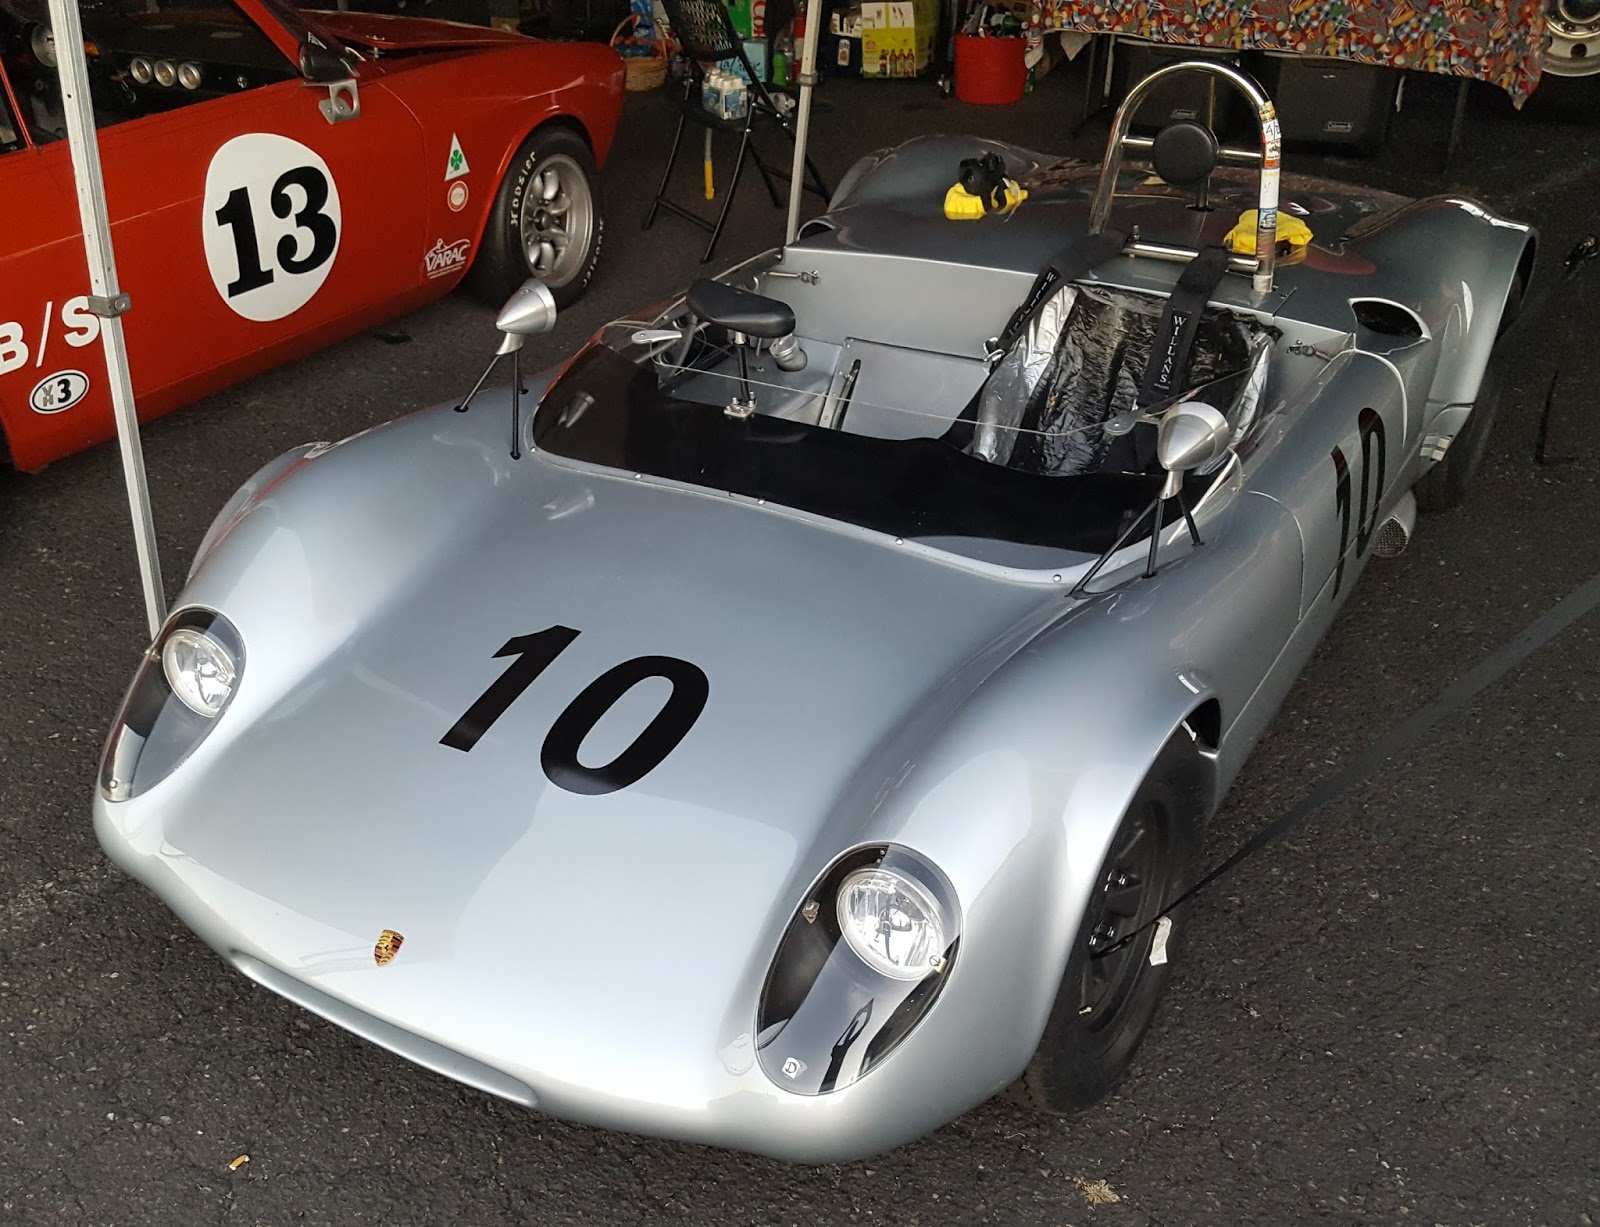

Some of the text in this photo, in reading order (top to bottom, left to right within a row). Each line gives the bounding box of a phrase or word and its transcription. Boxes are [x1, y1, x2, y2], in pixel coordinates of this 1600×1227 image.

[215, 166, 337, 298] 13
[424, 244, 471, 272] VARAC
[0, 295, 100, 376] B/S
[1159, 315, 1187, 383] WILLANS
[57, 378, 72, 403] 3
[1330, 407, 1386, 602] 10
[438, 624, 710, 796] 10
